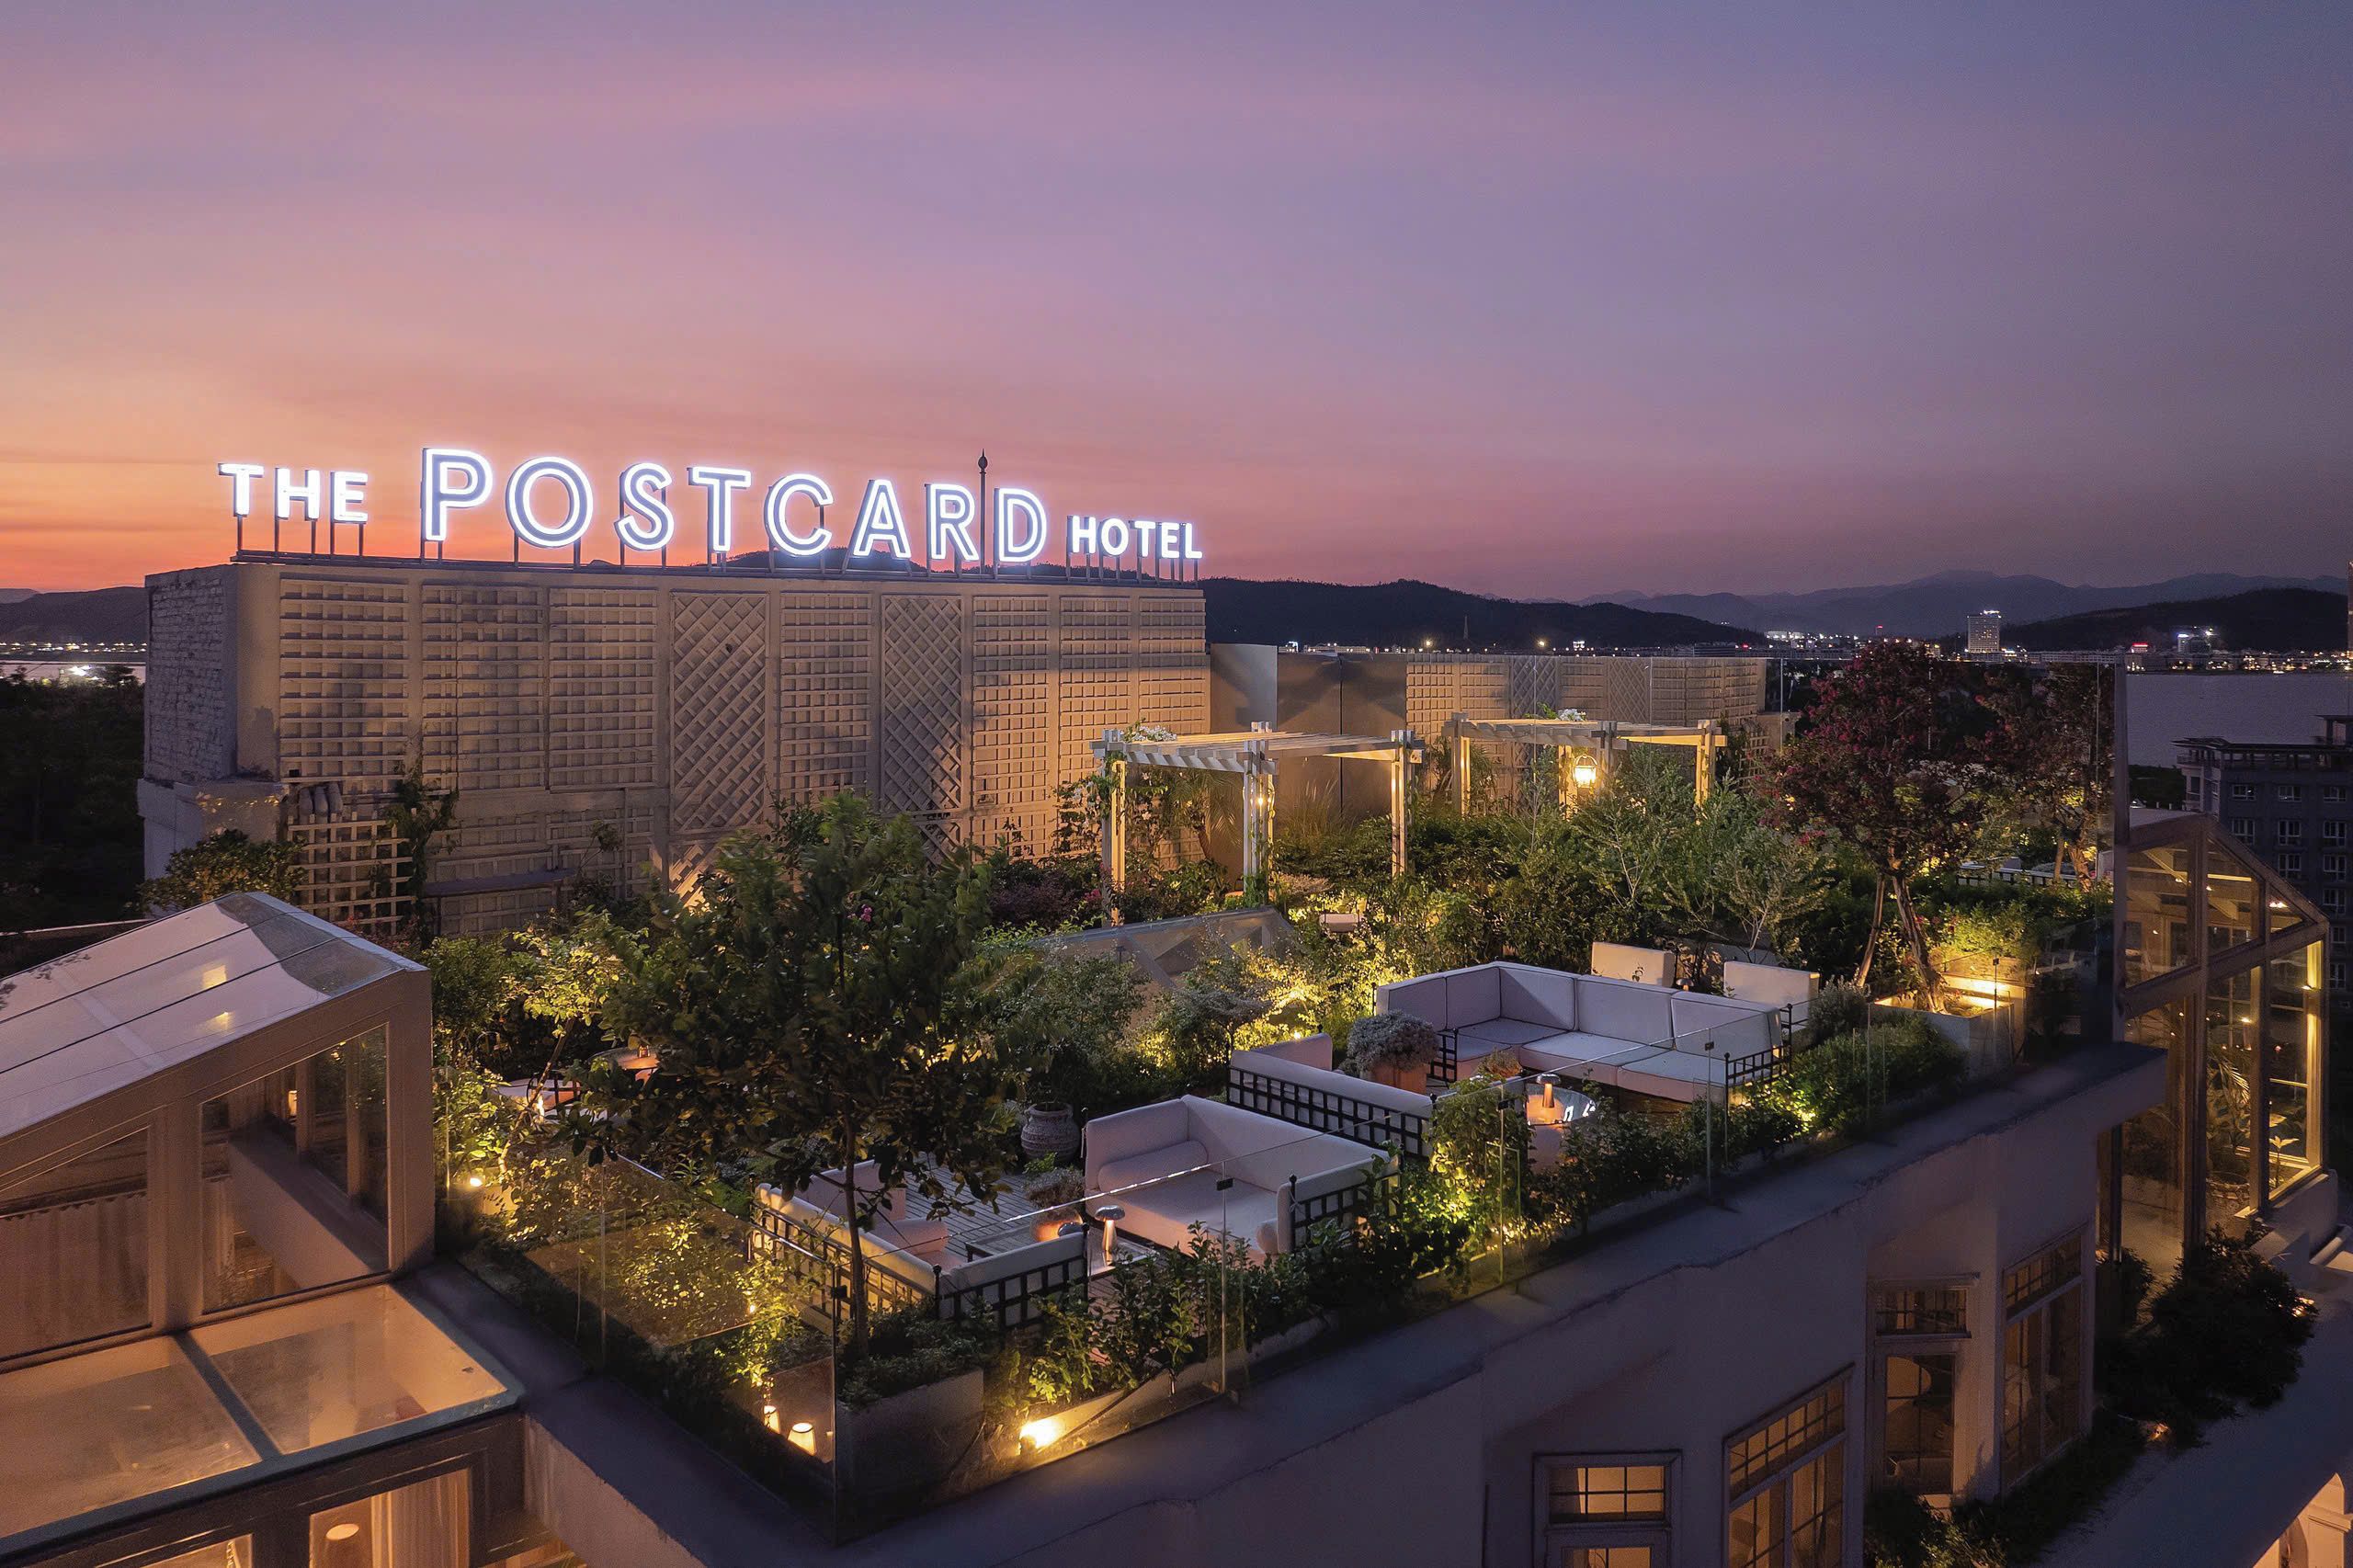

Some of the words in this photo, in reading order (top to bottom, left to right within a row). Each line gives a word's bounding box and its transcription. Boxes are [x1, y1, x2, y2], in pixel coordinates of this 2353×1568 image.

[218, 461, 369, 521] THE
[422, 448, 1048, 562] POSTCARD
[1069, 515, 1203, 559] HOTEL
